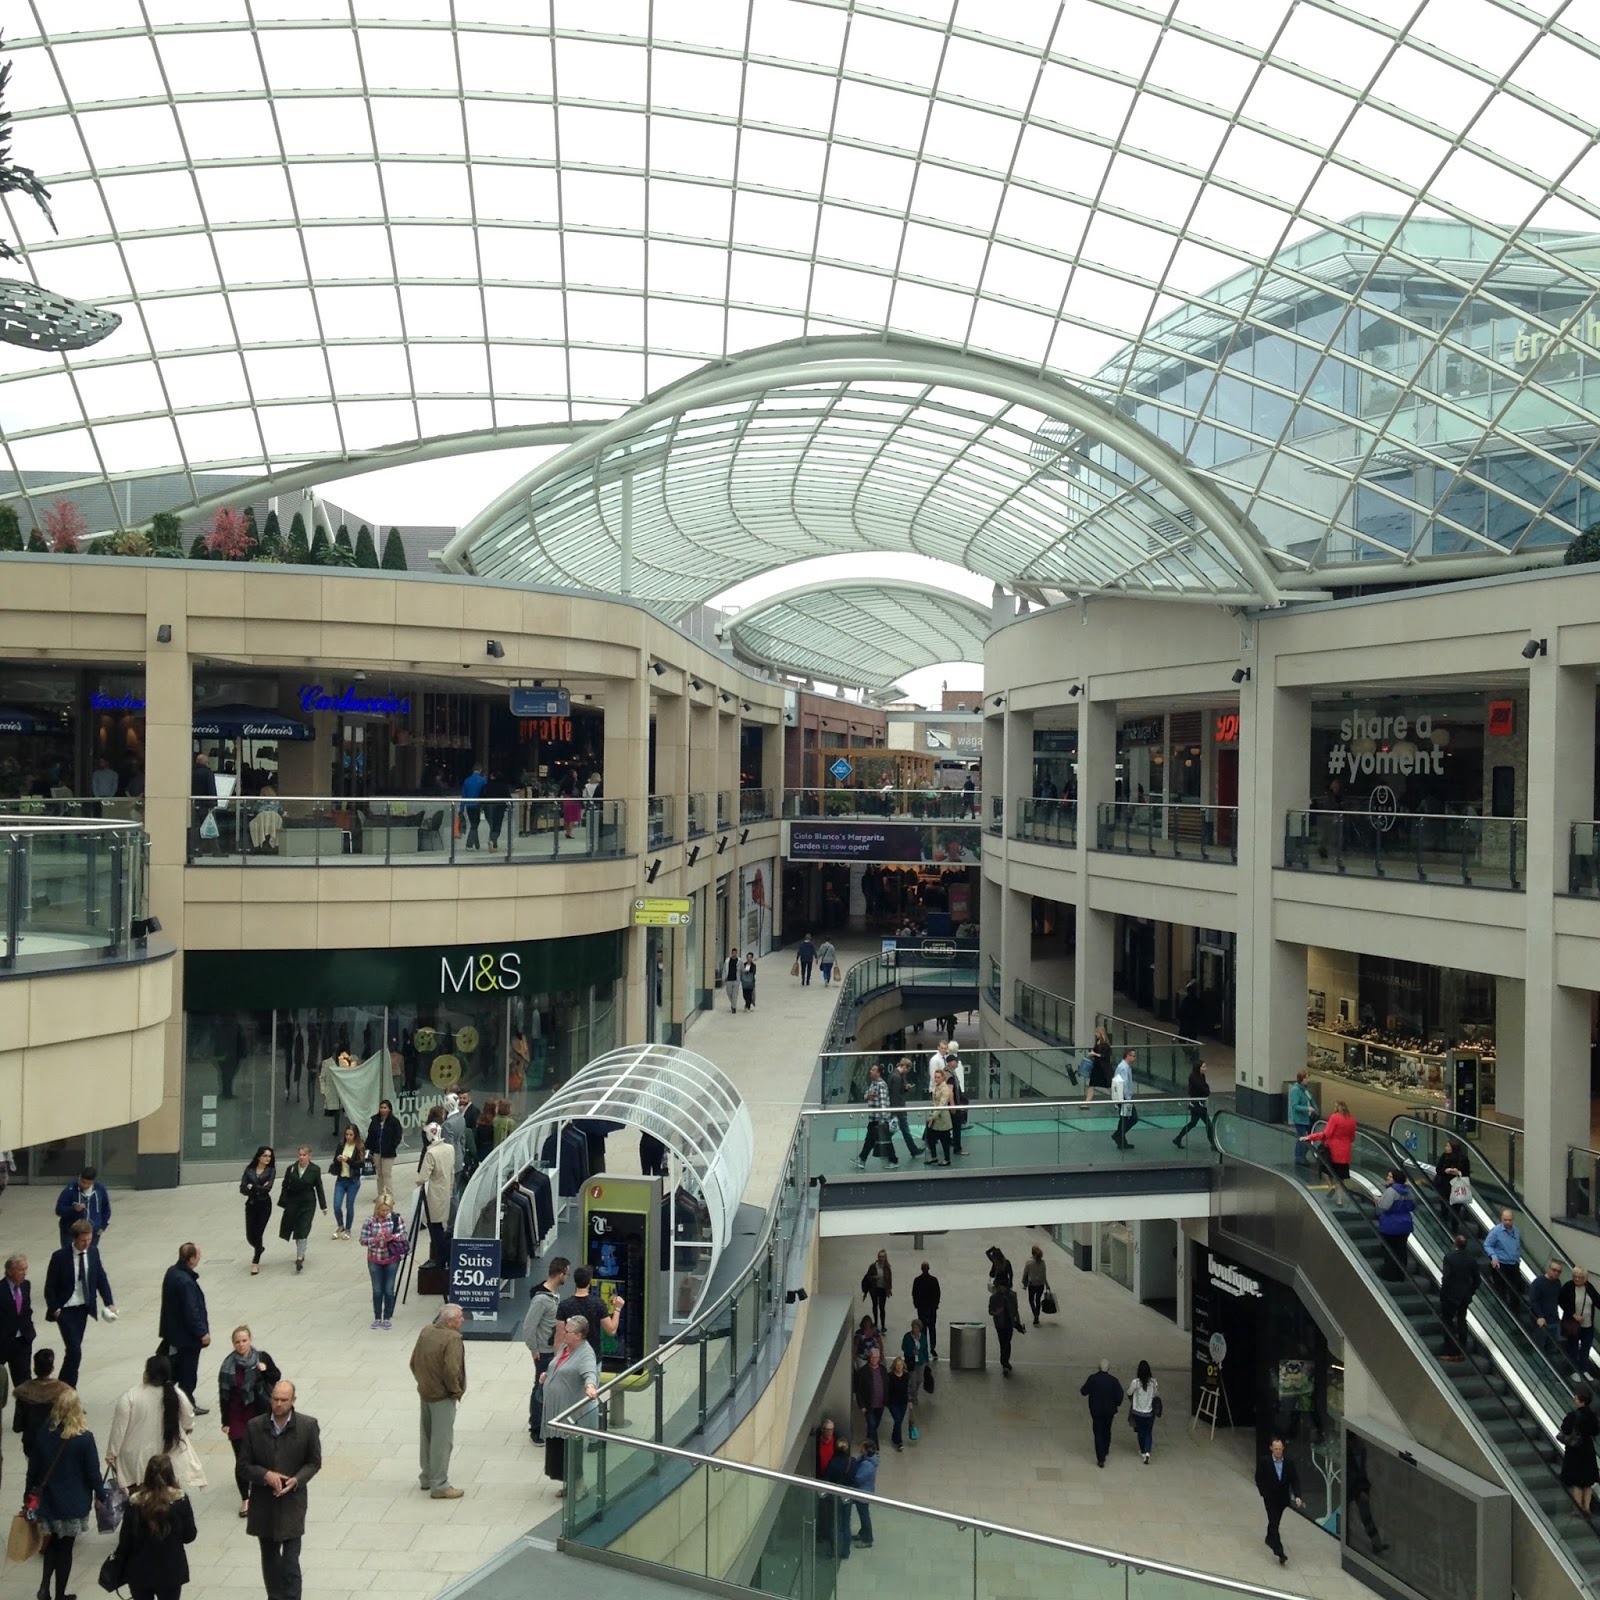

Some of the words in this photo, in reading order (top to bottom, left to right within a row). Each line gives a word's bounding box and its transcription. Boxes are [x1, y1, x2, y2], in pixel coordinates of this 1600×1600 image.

[193, 724, 219, 734] uccio's
[243, 723, 293, 736] Carluccio's
[519, 716, 573, 744] graffe
[1341, 709, 1408, 741] share
[1416, 715, 1432, 738] a
[1328, 744, 1445, 783] #yoment
[793, 832, 813, 840] Cielo
[814, 833, 846, 841] Blanco's
[847, 833, 885, 842] Margarita
[793, 841, 821, 850] Garden
[822, 842, 829, 850] is
[848, 842, 870, 852] open!
[441, 952, 522, 994] M&S
[411, 1089, 421, 1097] OF
[396, 1094, 447, 1113] UTUMN
[458, 1253, 493, 1267] Suits
[452, 1269, 485, 1287] £50
[485, 1277, 499, 1287] off
